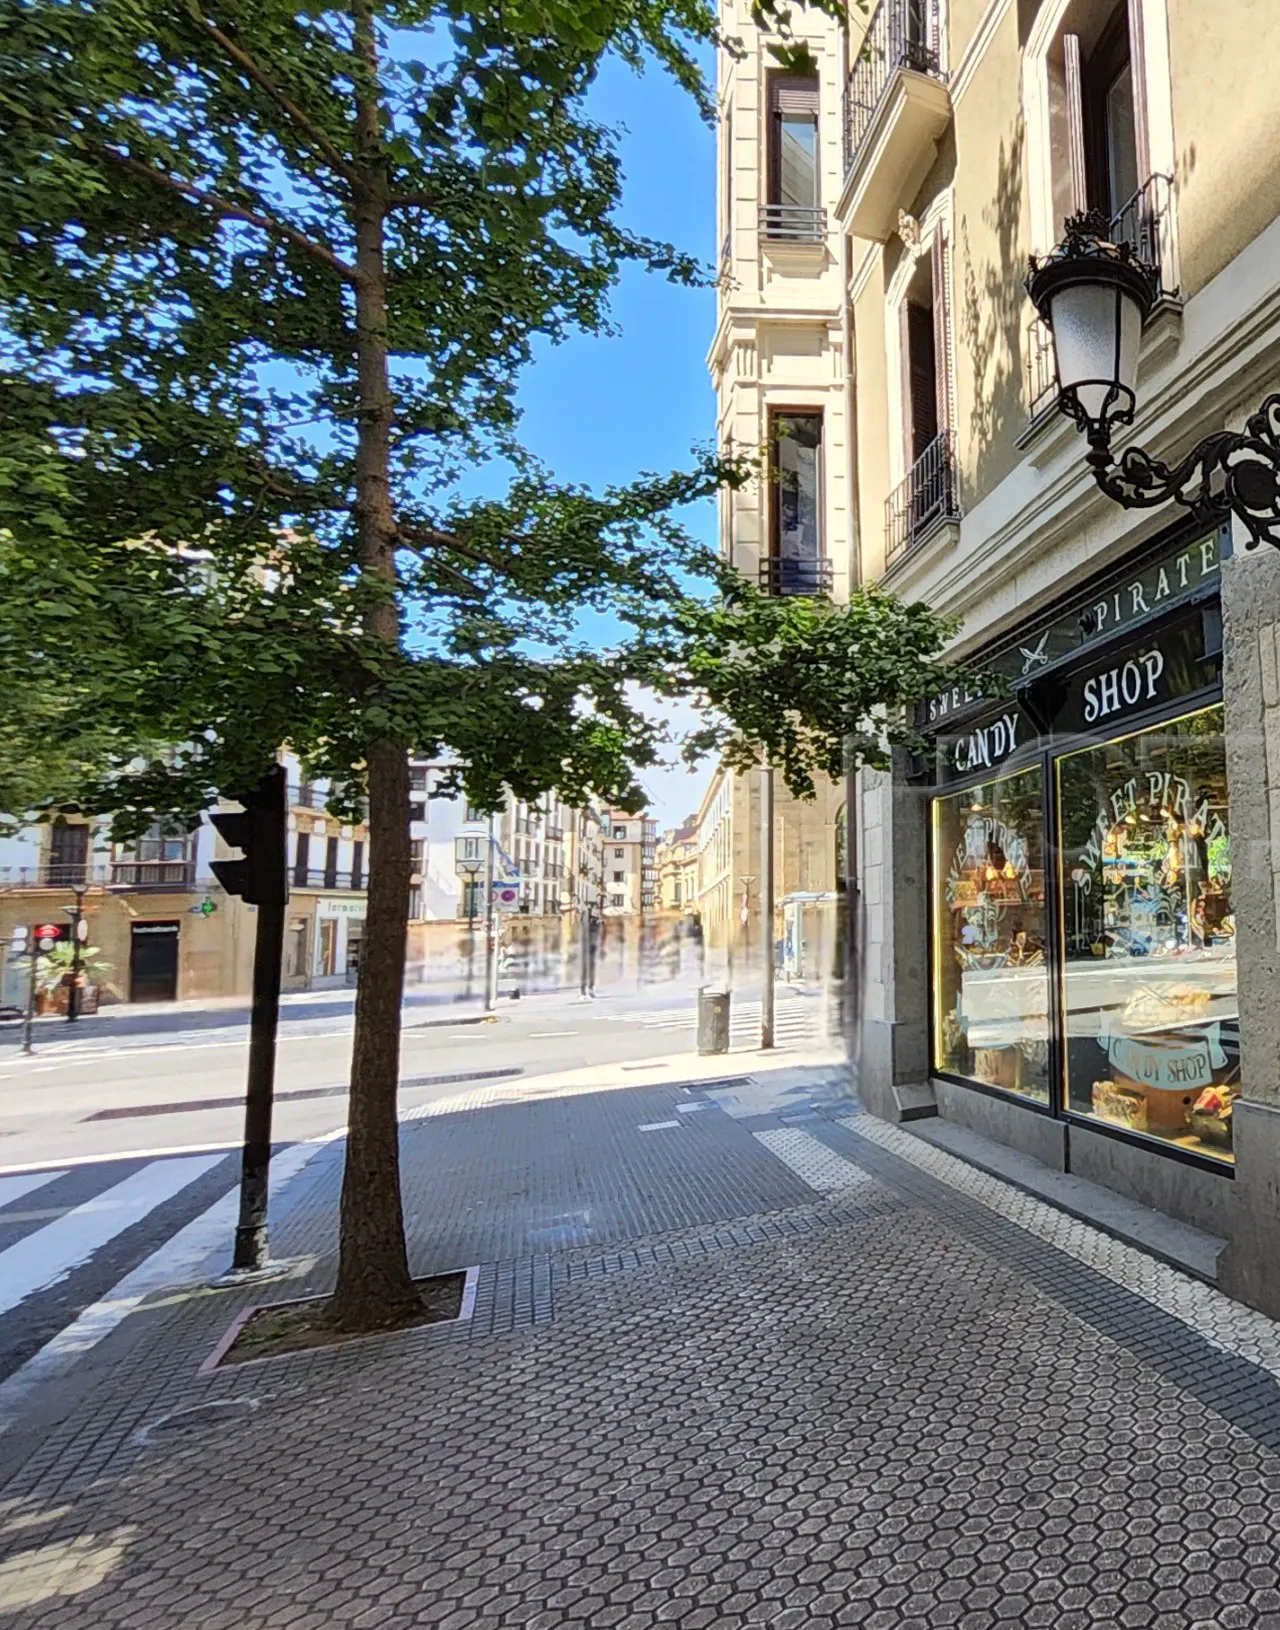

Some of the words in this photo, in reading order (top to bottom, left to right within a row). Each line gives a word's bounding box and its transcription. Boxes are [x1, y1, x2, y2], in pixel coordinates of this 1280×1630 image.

[928, 673, 983, 721] SWE
[1094, 538, 1219, 633] PIRATE
[954, 713, 1019, 772] CANDY
[1084, 650, 1164, 723] SHOP
[1167, 1053, 1206, 1083] SHOP
